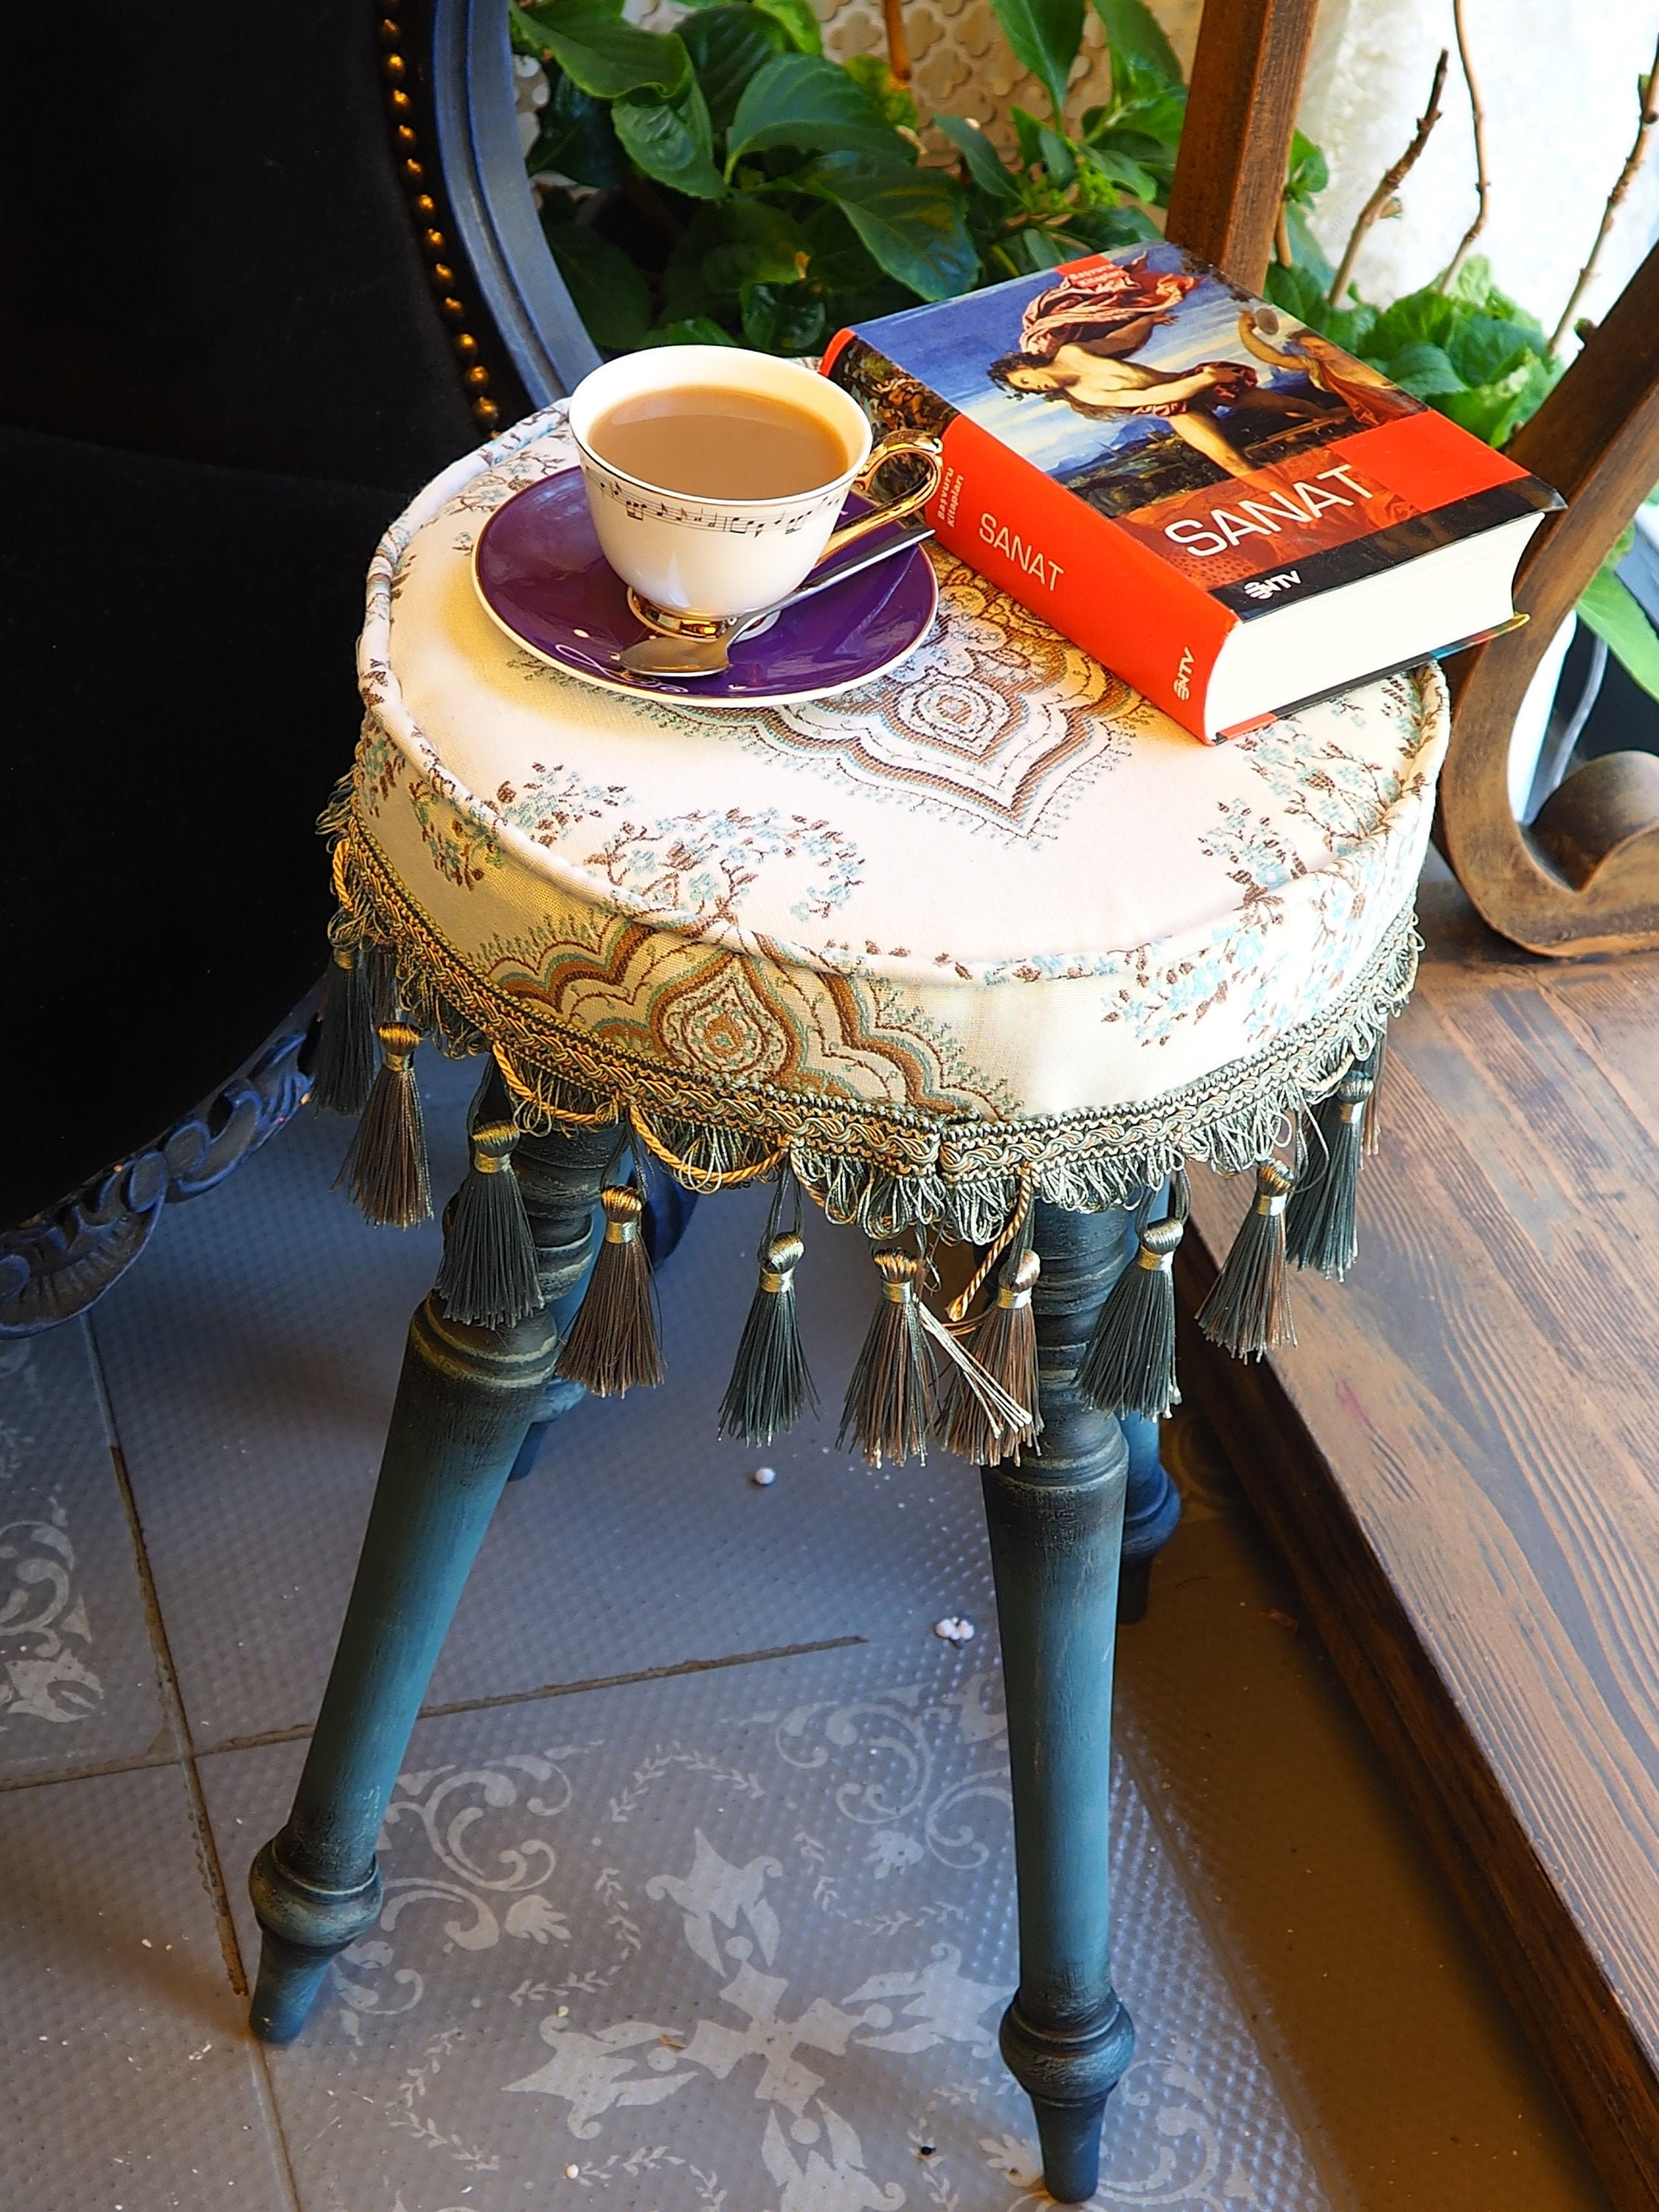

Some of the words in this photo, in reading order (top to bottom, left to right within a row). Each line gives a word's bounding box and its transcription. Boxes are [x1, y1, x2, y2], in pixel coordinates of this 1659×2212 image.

[937, 466, 954, 520] Başvuru
[947, 474, 964, 528] Kitapları
[1164, 464, 1374, 557] SANAT
[978, 512, 1065, 591] SANAT
[1252, 570, 1301, 597] NTV
[1175, 646, 1194, 695] NTV
